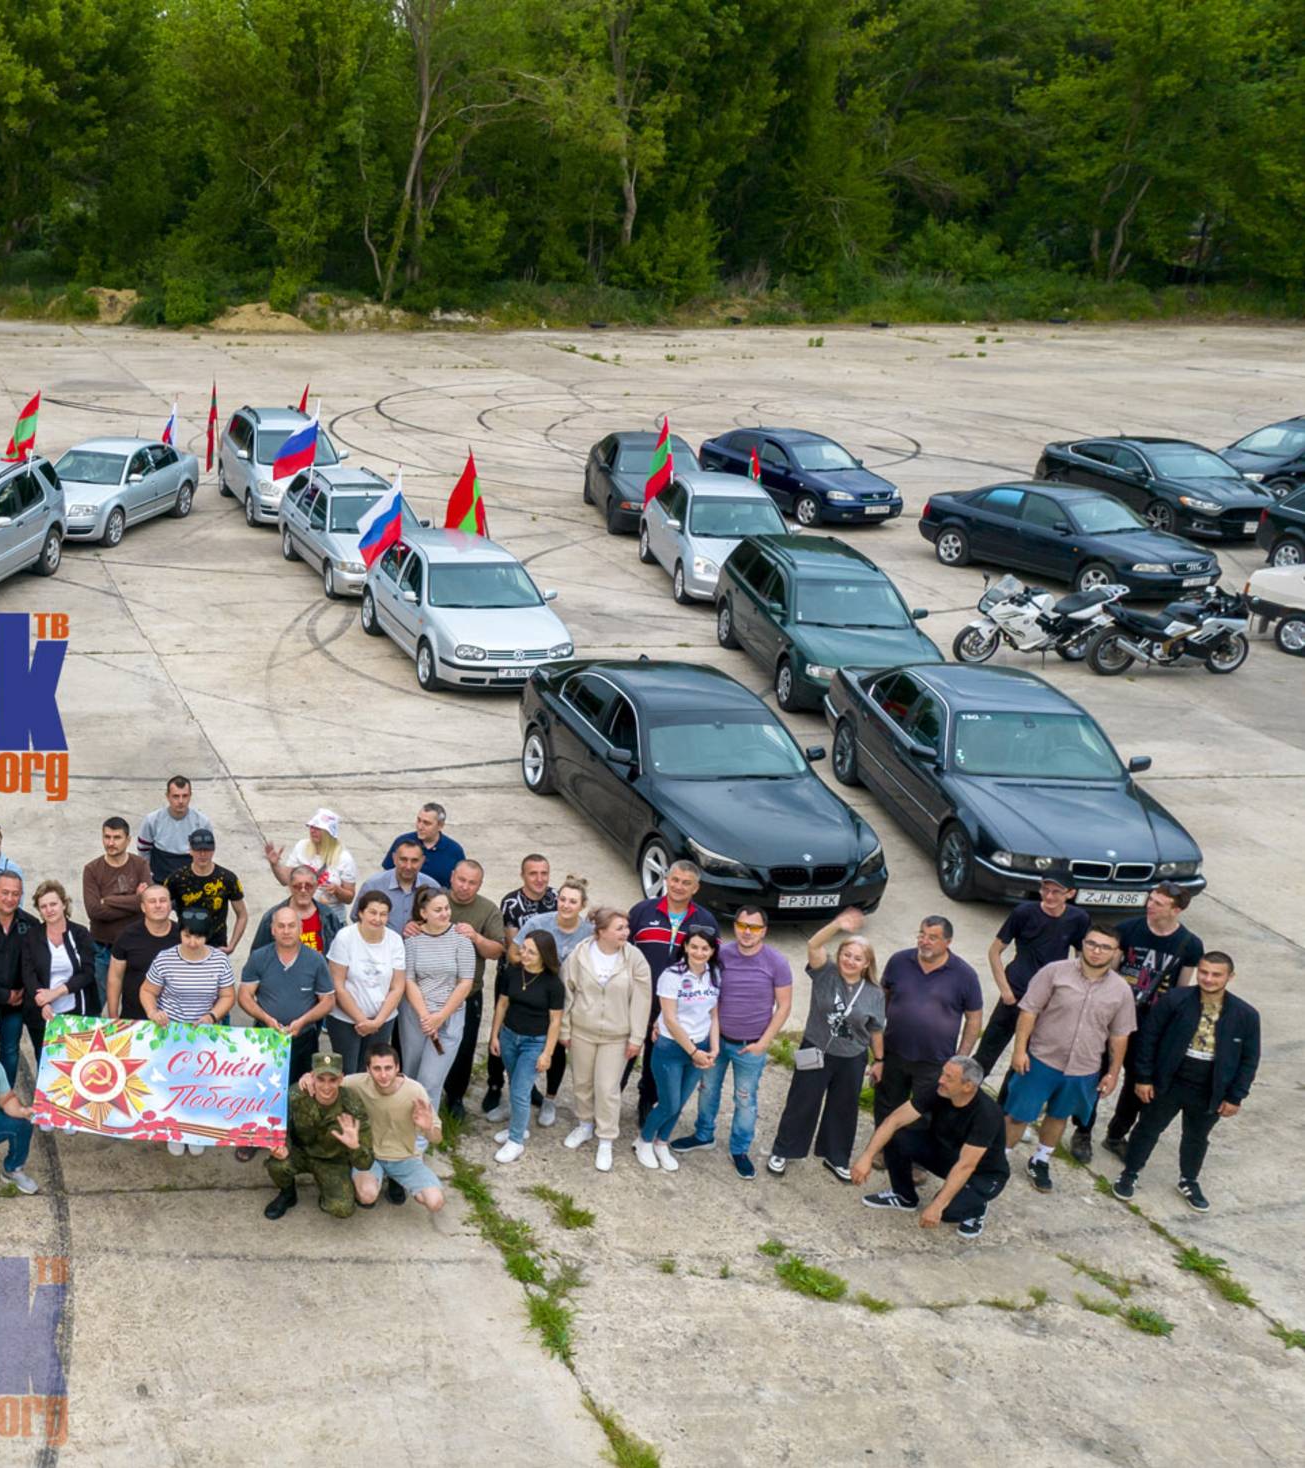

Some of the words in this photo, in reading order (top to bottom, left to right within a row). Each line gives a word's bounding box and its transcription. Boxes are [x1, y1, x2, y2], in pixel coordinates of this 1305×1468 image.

[1116, 893, 1139, 904] 896
[194, 1050, 267, 1078] Днём
[161, 1084, 282, 1121] Победы!
